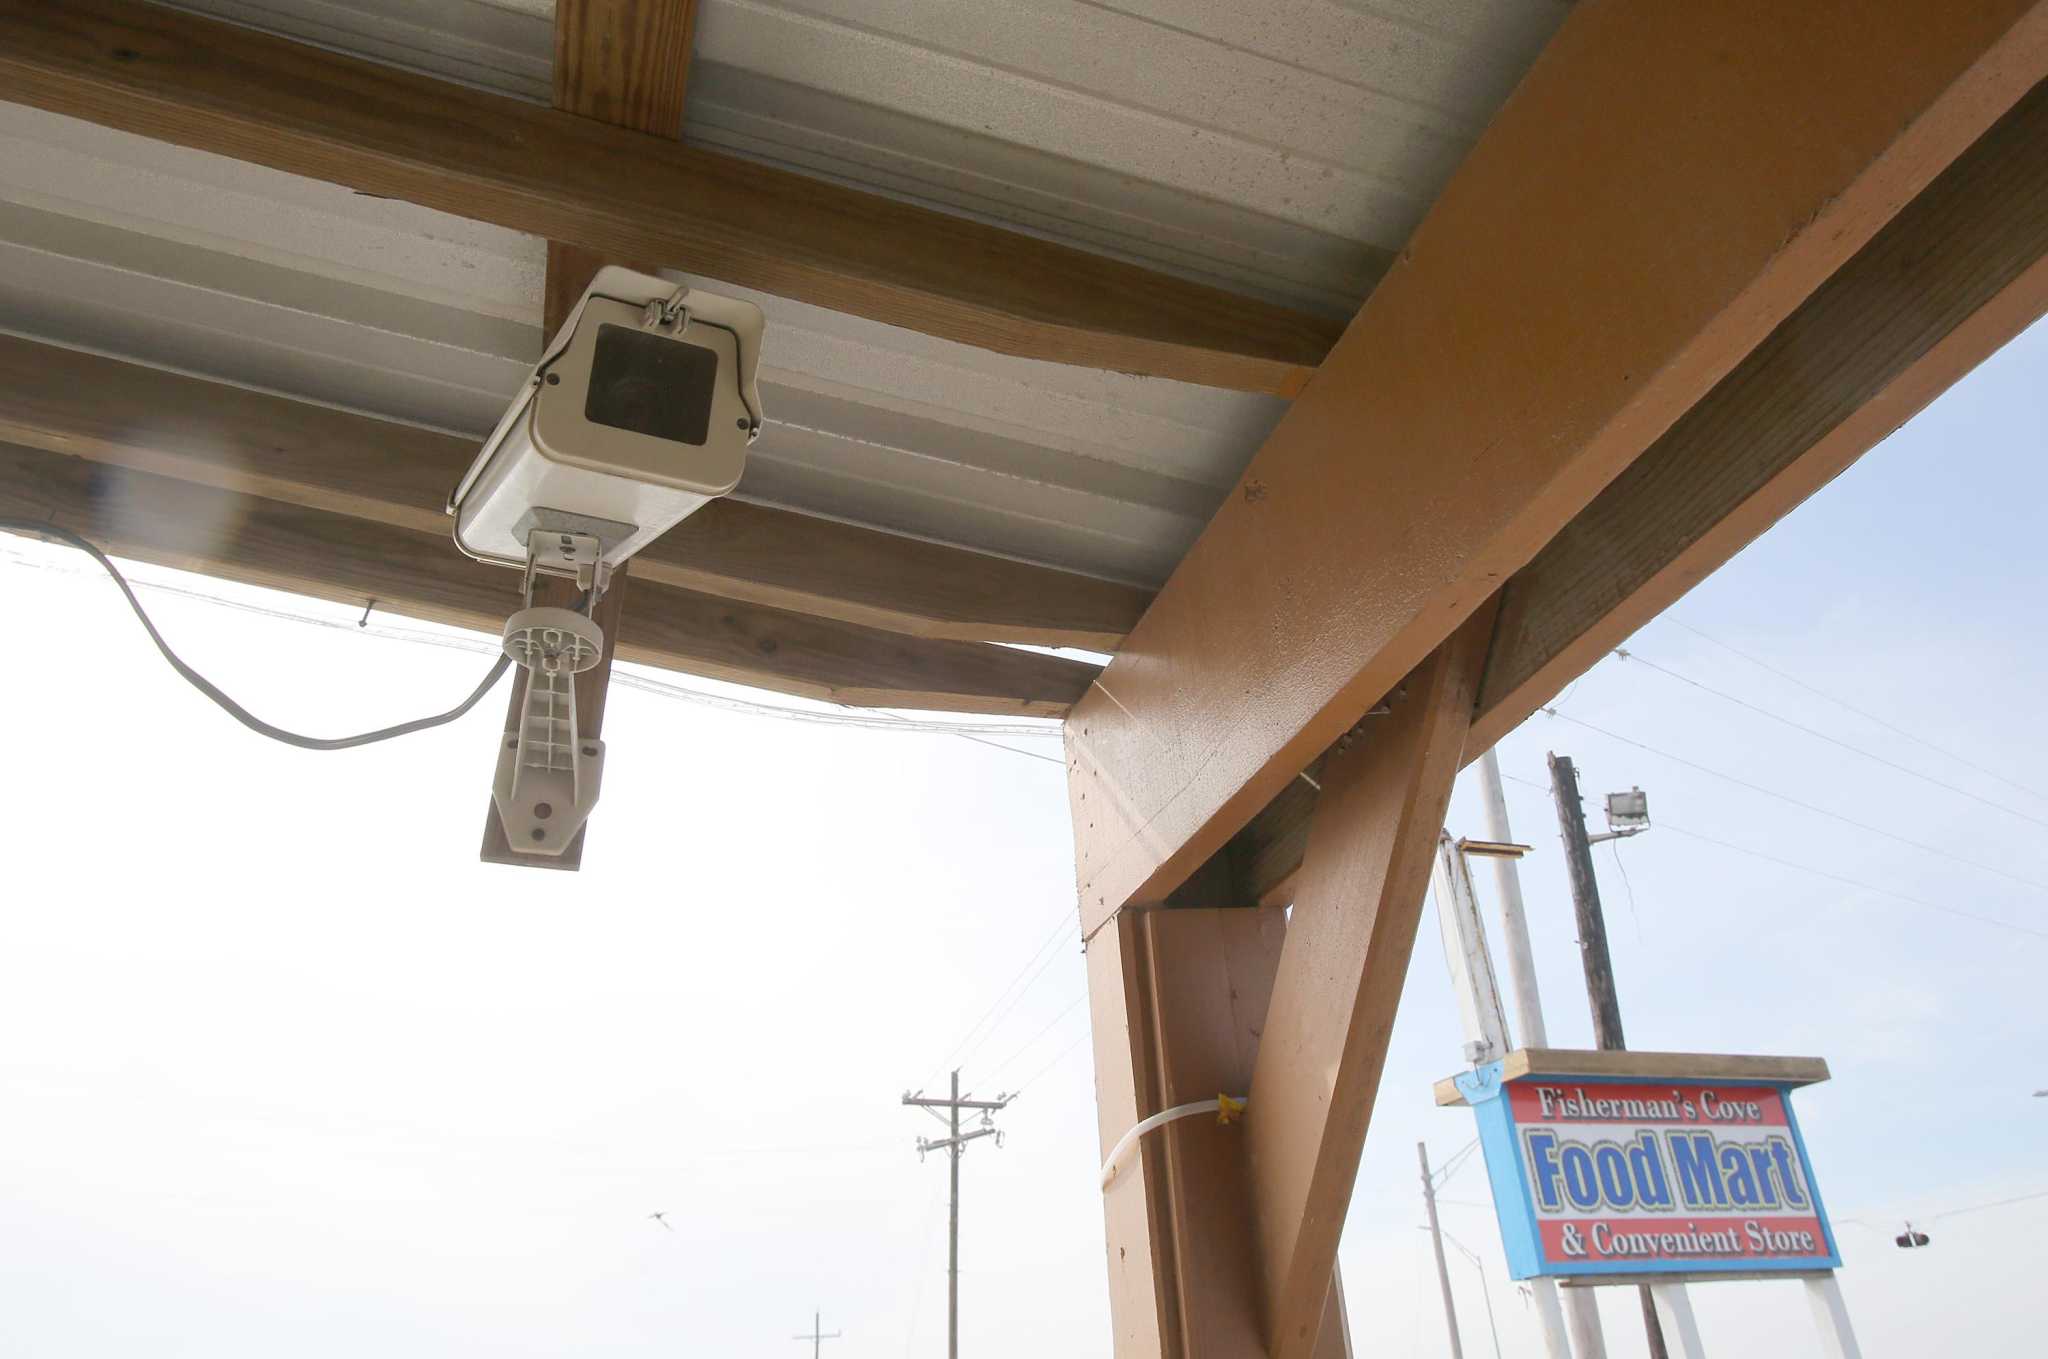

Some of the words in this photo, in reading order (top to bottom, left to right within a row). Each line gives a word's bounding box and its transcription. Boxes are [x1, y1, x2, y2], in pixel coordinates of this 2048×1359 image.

[1536, 1087, 1697, 1120] Fisherman's
[1701, 1091, 1762, 1121] Cove
[1526, 1131, 1672, 1210] Food
[1666, 1132, 1808, 1210] Mart
[1561, 1222, 1588, 1256] &
[1591, 1222, 1743, 1256] Convenient
[1744, 1221, 1815, 1252] Store
